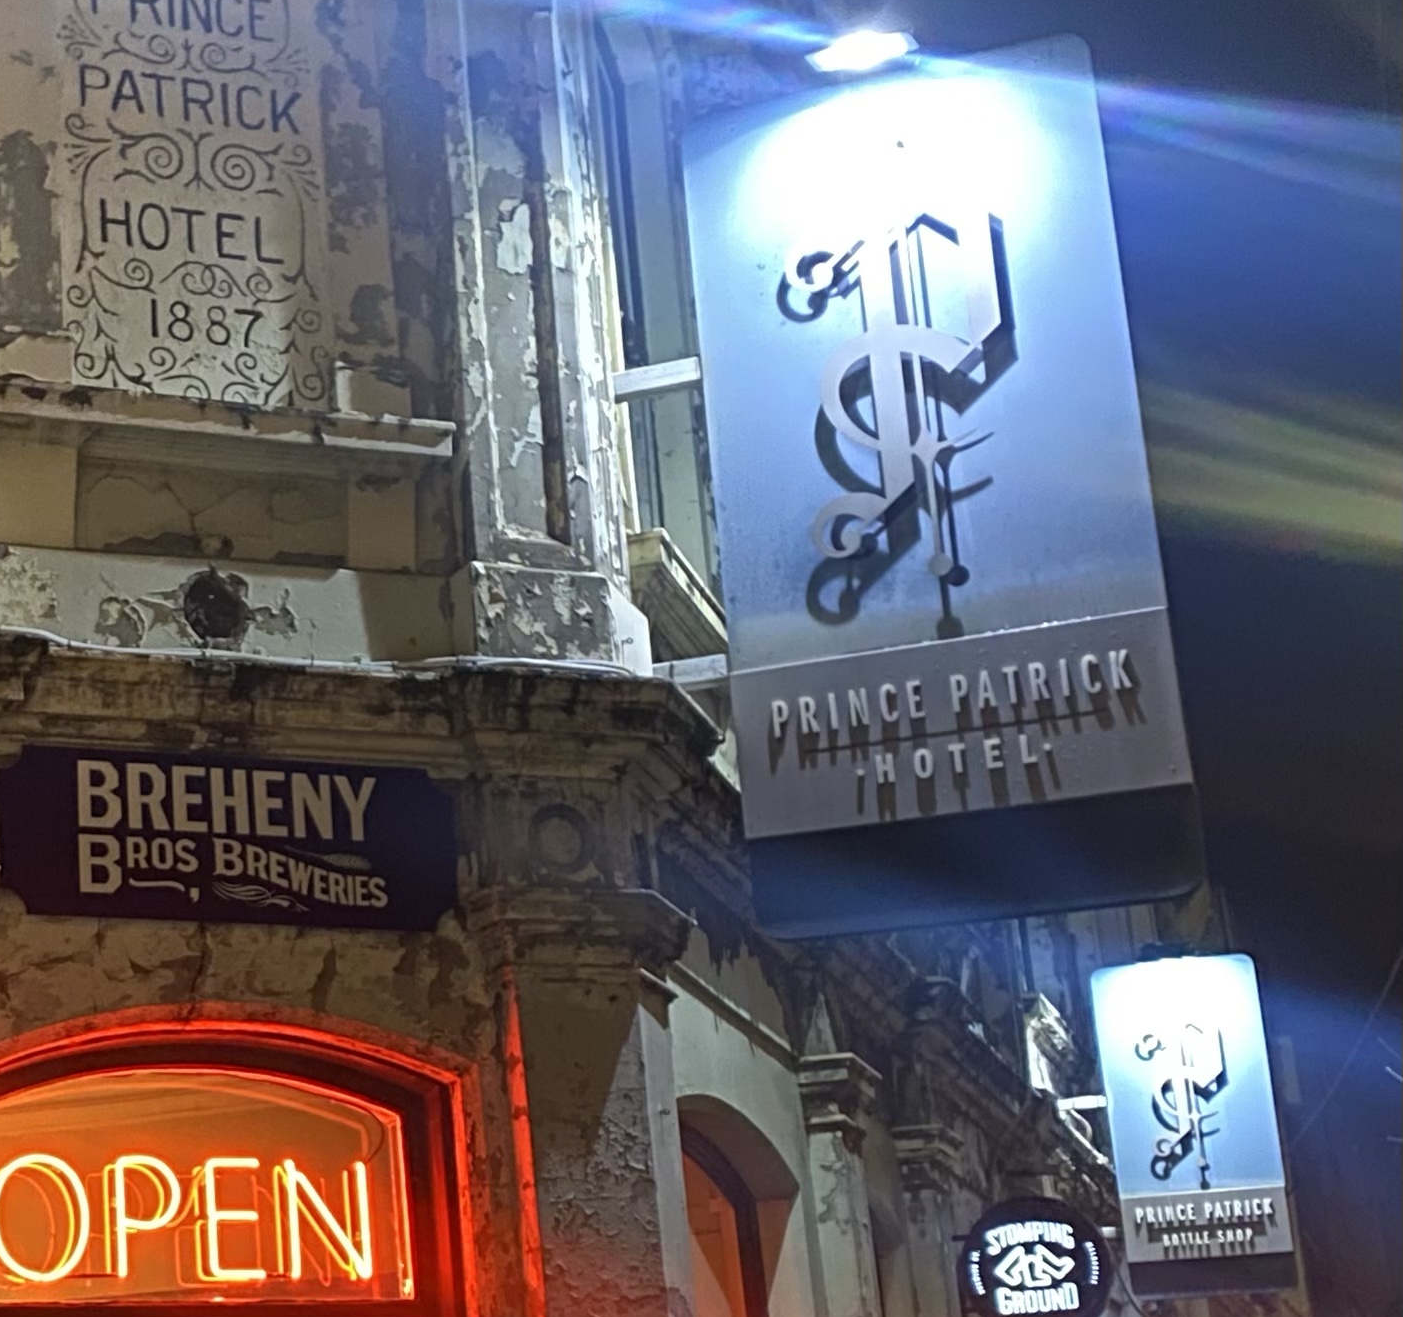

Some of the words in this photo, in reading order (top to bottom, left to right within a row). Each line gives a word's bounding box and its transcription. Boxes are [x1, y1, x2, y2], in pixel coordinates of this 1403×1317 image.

[79, 63, 302, 135] PATRICK
[100, 197, 285, 265] HOTEL
[150, 298, 264, 348] 1887
[771, 680, 926, 738] PRINCE
[950, 649, 1133, 713] PATRICK
[77, 759, 376, 841] BREHENY
[212, 837, 389, 908] BREWERIES
[985, 1220, 1076, 1256] STOMPING
[1135, 1203, 1196, 1224] PRINCE
[1204, 1197, 1273, 1219] PATRICK
[1162, 1231, 1210, 1247] BOTTLE
[1218, 1228, 1253, 1243] SHOP
[997, 1282, 1080, 1315] GROUND
